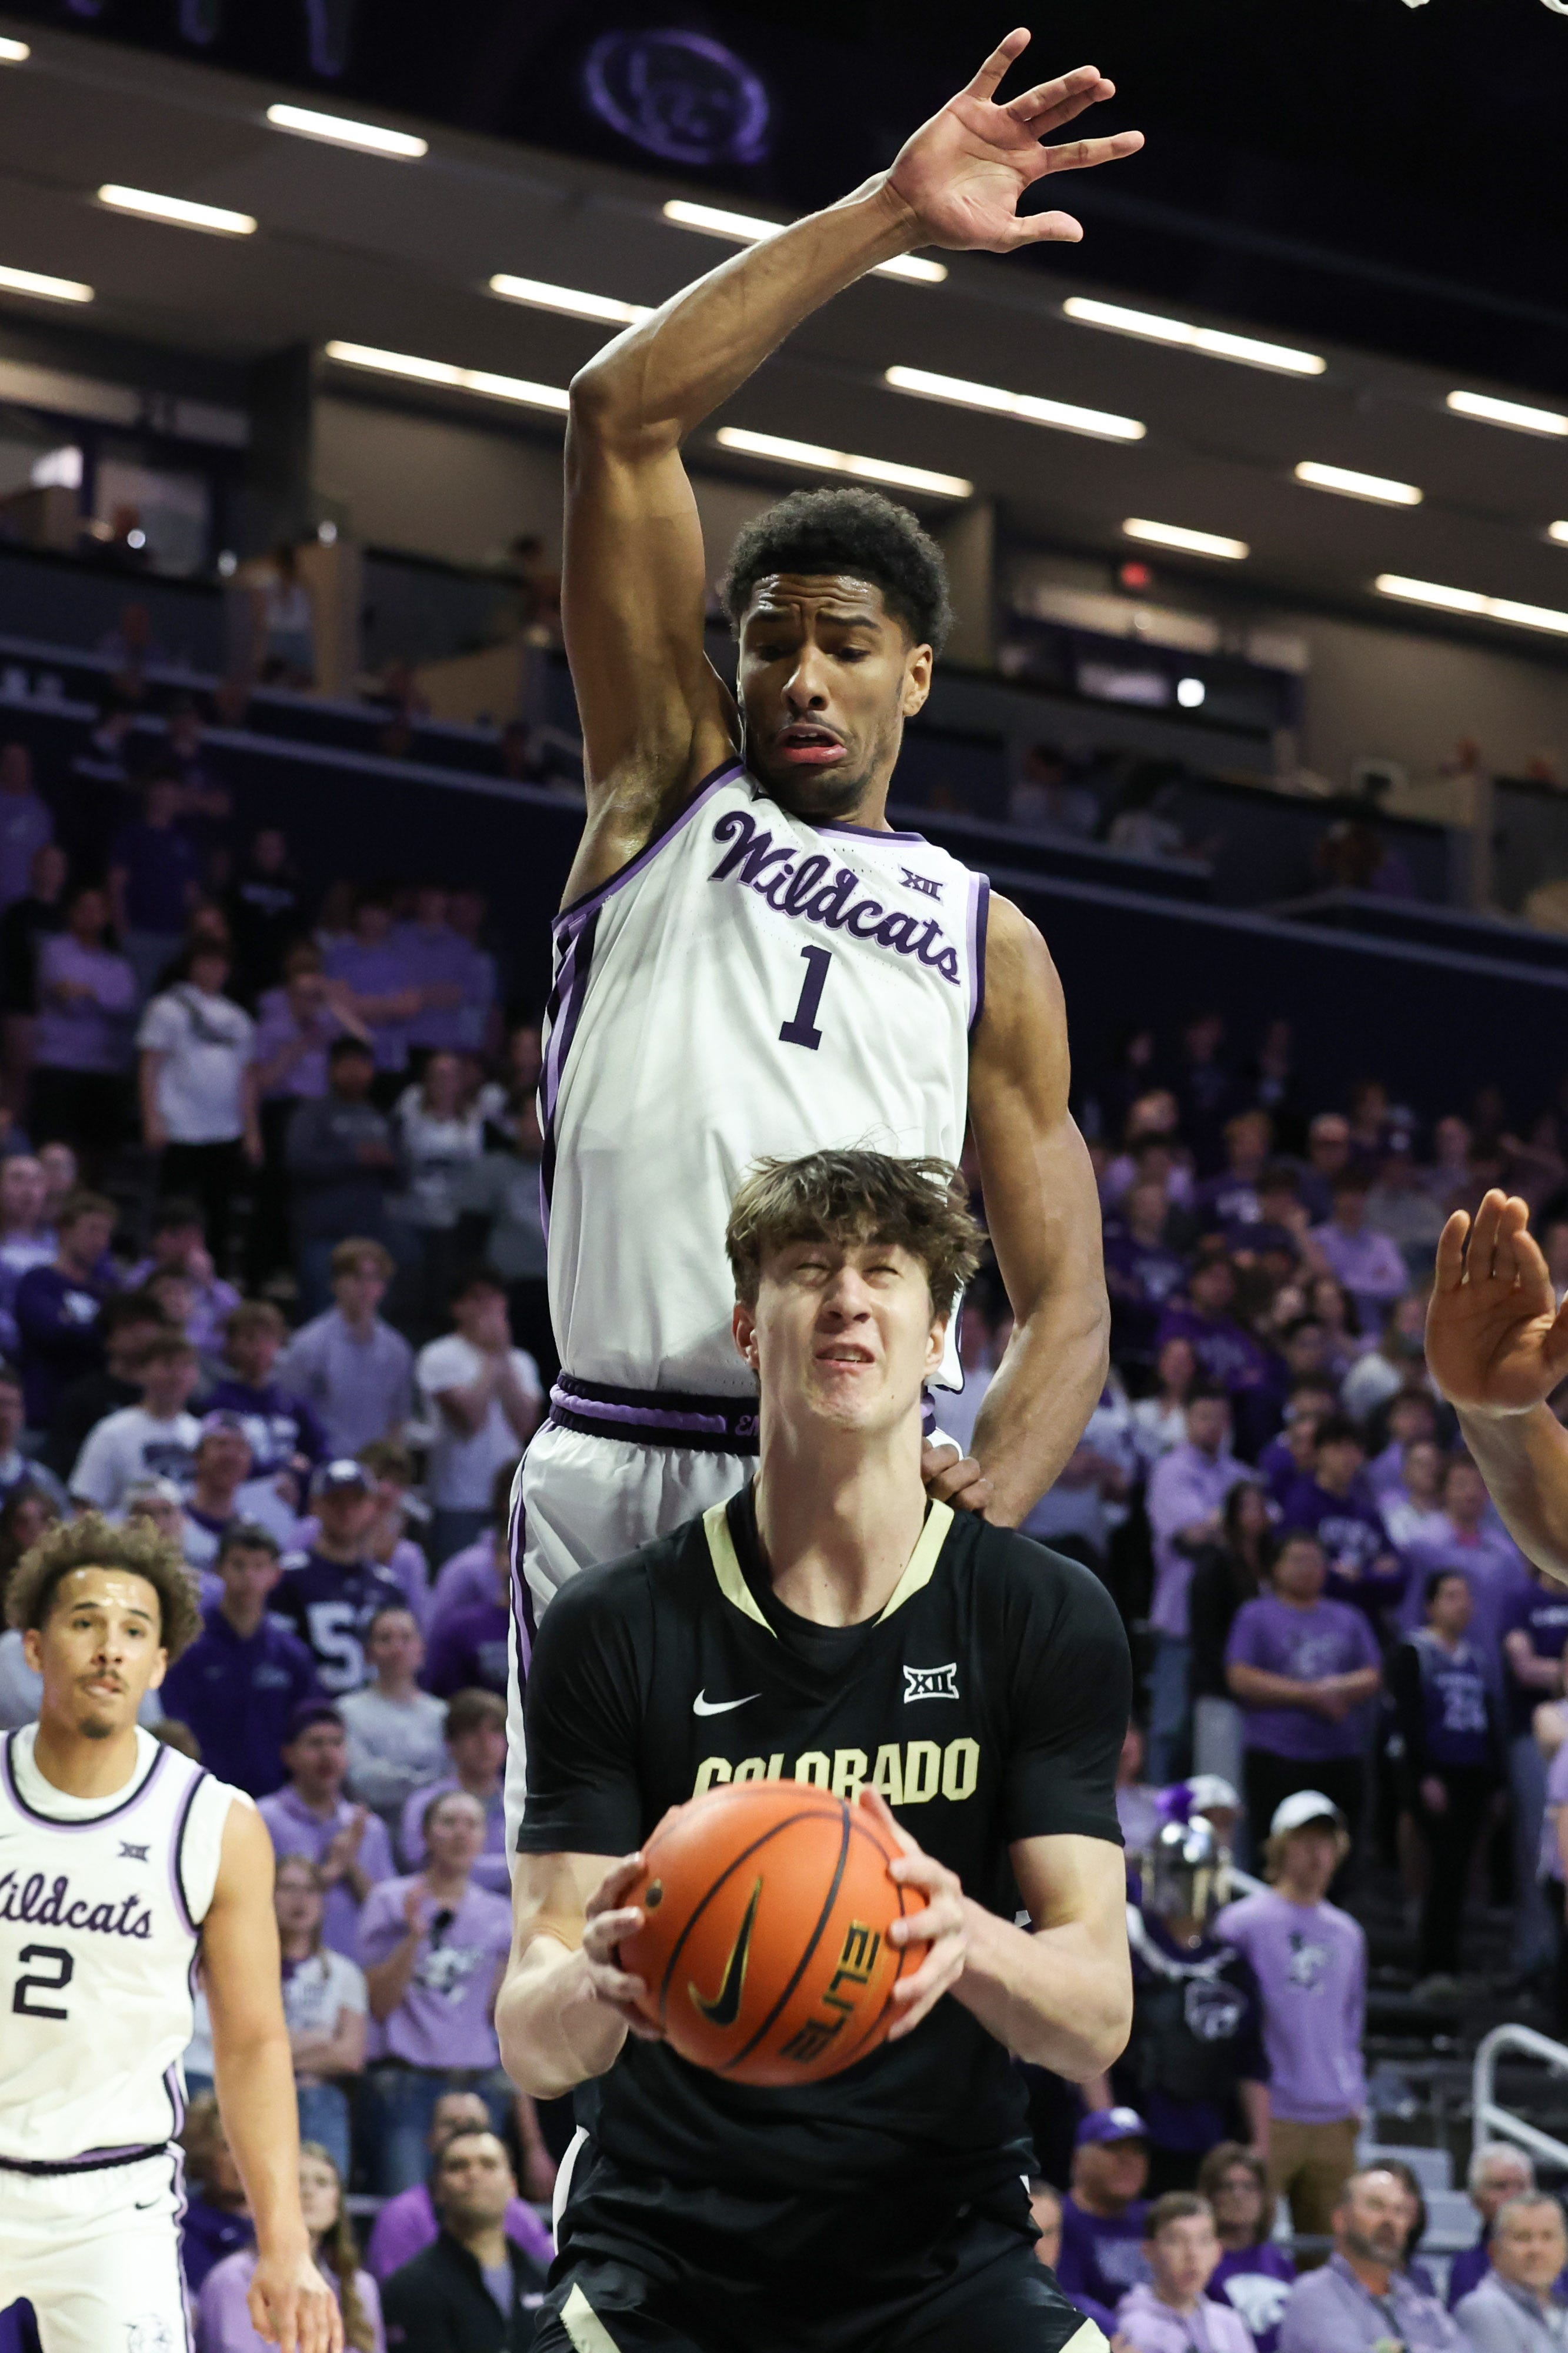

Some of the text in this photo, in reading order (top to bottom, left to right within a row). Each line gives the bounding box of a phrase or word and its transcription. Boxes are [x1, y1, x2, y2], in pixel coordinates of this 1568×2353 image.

[708, 810, 961, 987] Wildcats
[898, 865, 945, 903] XII
[779, 944, 832, 1051] 1
[906, 1667, 956, 1699] XII
[0, 1869, 152, 1939] ildcats
[12, 1944, 74, 2020] 2
[778, 1920, 881, 2064] ELITE
